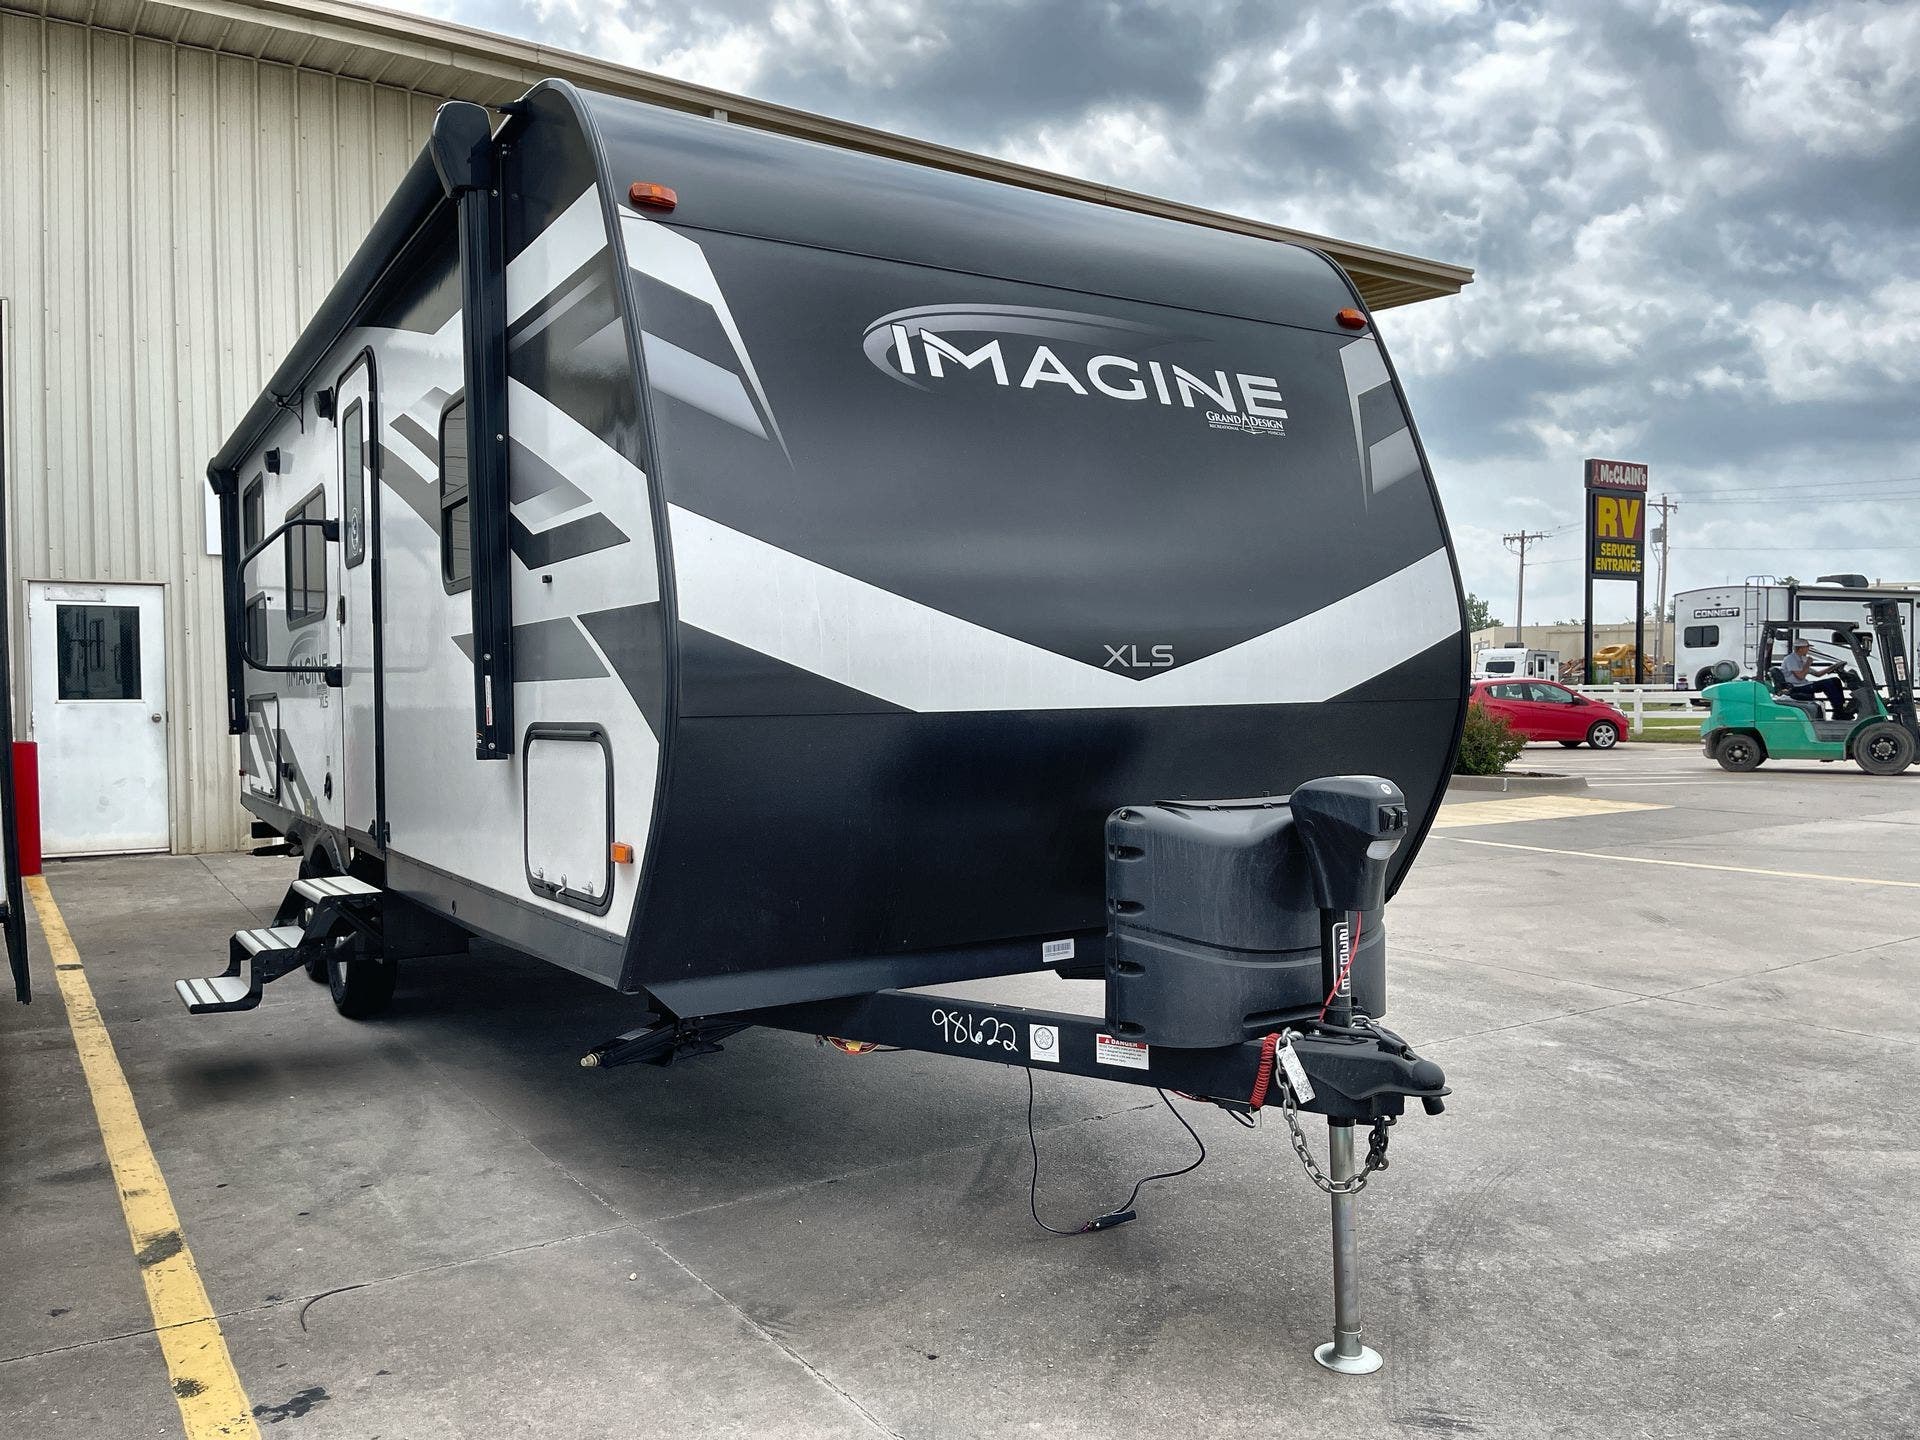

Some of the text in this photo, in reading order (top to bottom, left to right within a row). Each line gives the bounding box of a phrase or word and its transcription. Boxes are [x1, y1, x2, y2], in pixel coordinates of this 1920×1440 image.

[890, 323, 1289, 419] IMAGINE
[1205, 411, 1284, 429] GRAND DESIGN
[1598, 496, 1640, 538] RV
[1601, 543, 1636, 557] SERVICE
[1595, 557, 1642, 573] ENTRANCE
[1694, 608, 1739, 618] CONNECT
[1103, 644, 1175, 667] XLS
[931, 1009, 1019, 1052] 98622
